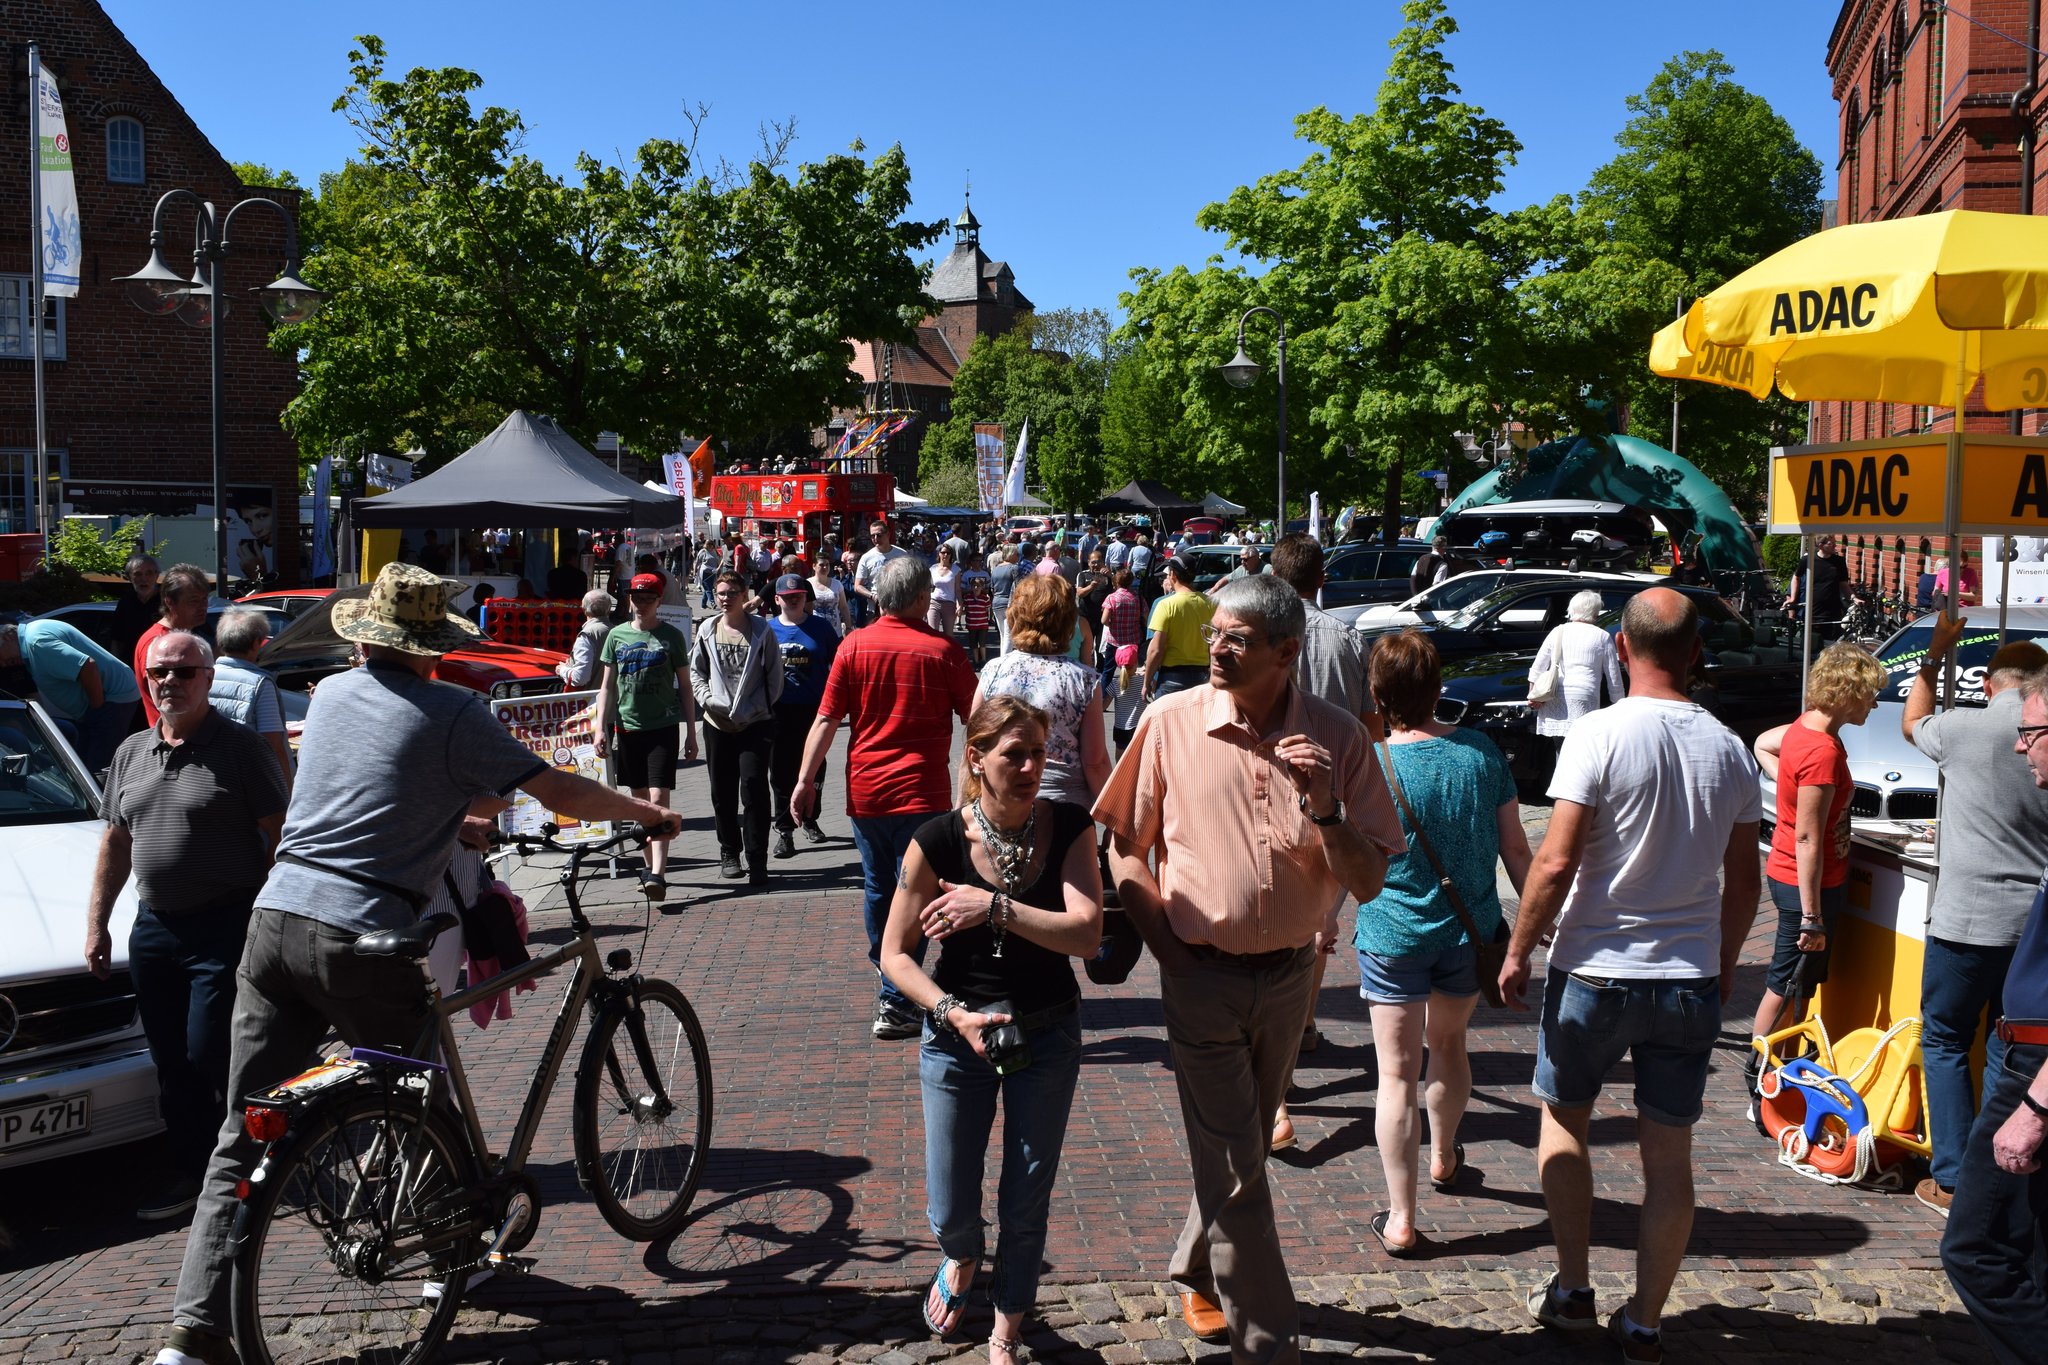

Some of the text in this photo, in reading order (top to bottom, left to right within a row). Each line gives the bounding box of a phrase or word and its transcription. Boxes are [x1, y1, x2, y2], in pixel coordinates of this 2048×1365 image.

[1770, 283, 1878, 336] ADAC
[89, 487, 121, 497] Catering
[715, 483, 734, 507] Big
[1803, 454, 1909, 517] ADAC
[497, 699, 593, 723] OLDTIMER-
[0, 1101, 85, 1143] P 47H
